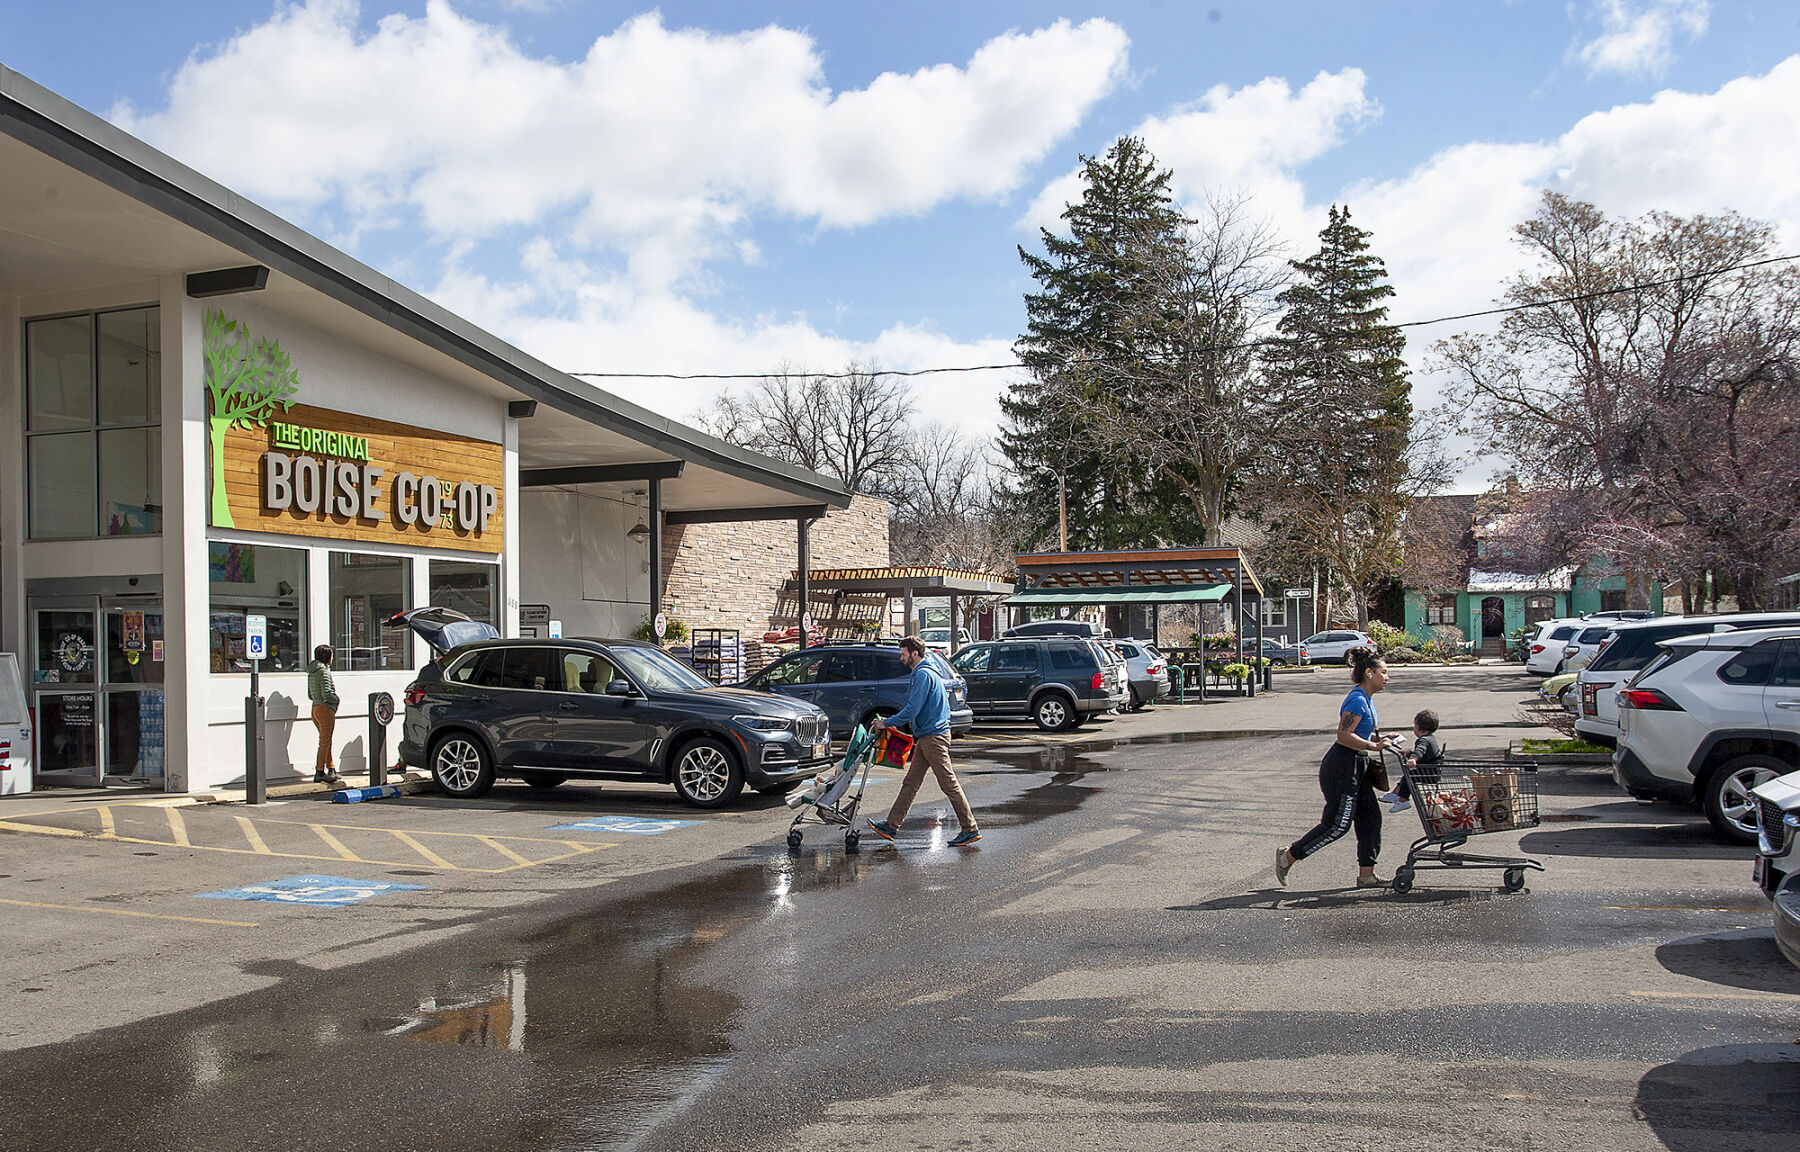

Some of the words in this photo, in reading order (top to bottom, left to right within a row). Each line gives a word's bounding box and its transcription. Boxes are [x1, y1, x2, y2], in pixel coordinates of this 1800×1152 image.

[273, 421, 300, 444] THE
[301, 427, 374, 461] ORIGINAL
[266, 451, 385, 519] BOISE
[397, 471, 498, 532] CO-OP
[440, 480, 453, 497] 19
[440, 513, 454, 529] 73
